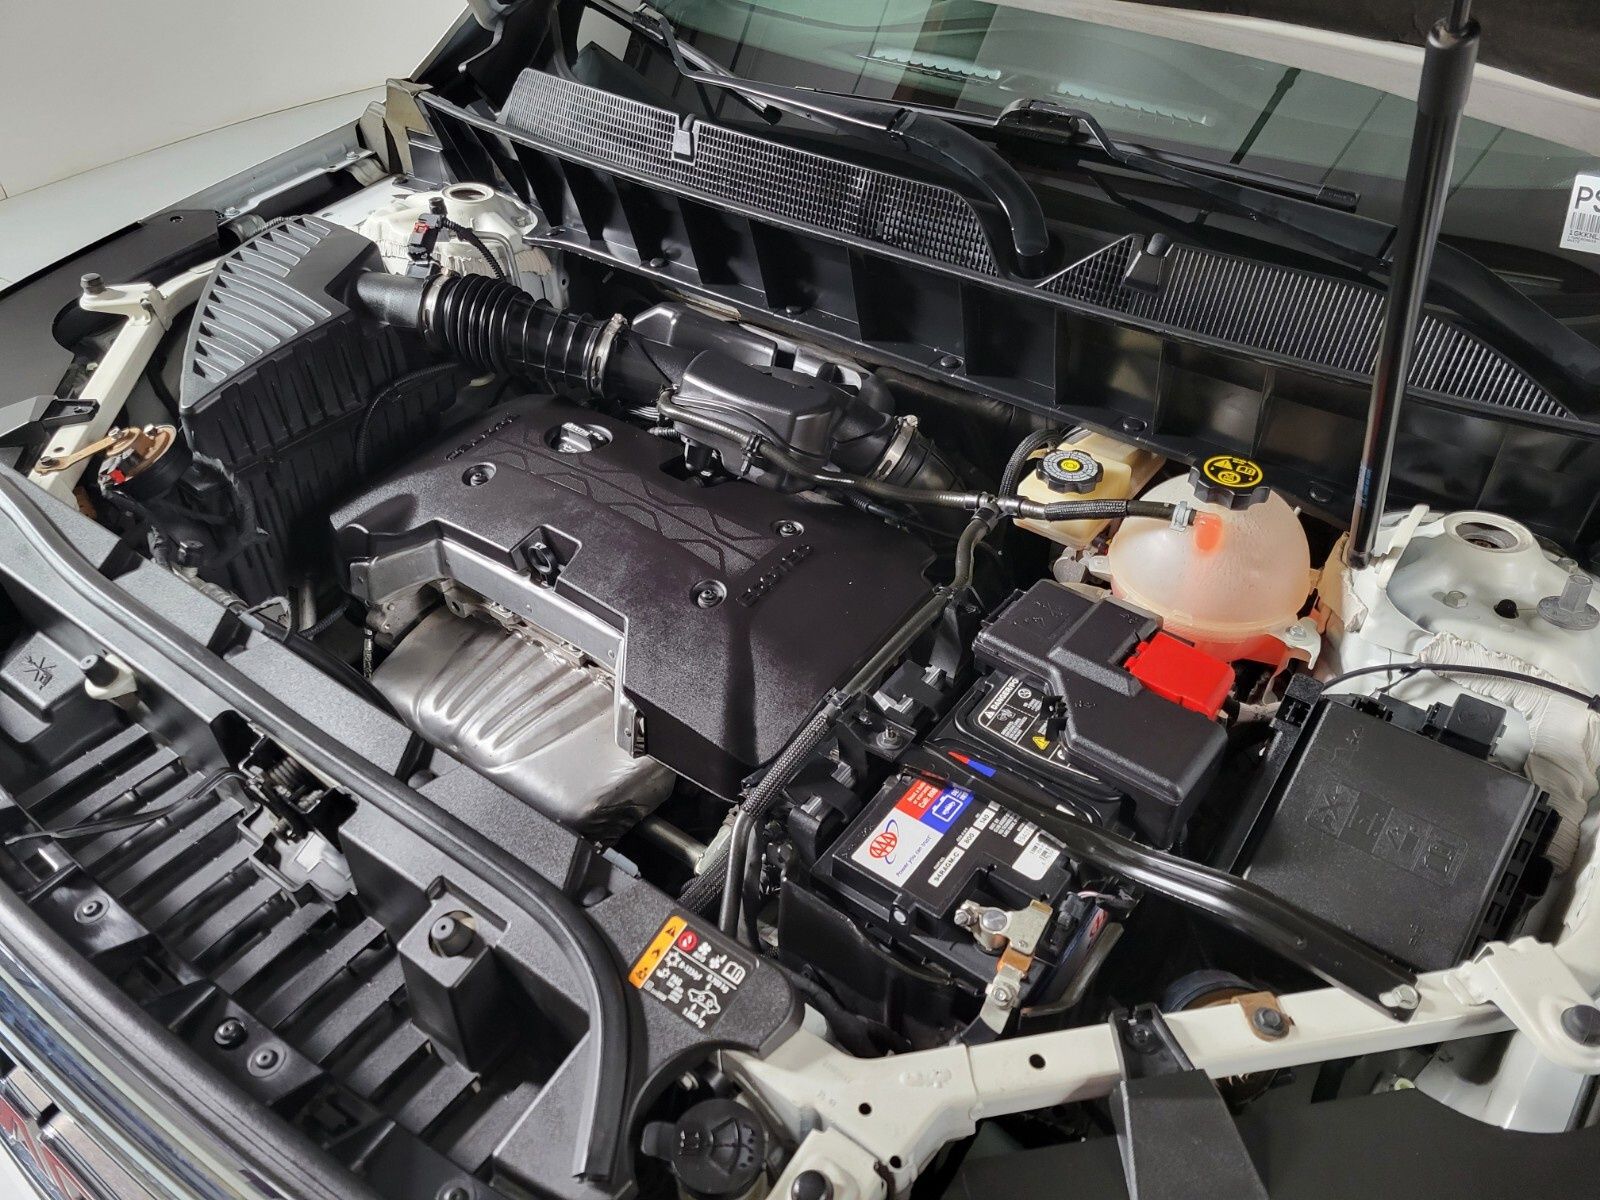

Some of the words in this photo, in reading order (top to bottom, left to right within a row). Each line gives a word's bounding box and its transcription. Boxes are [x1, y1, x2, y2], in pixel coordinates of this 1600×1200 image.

[870, 832, 897, 858] AAA
[895, 861, 909, 877] Power
[906, 853, 917, 864] you
[914, 845, 923, 855] can
[920, 834, 932, 847] trust
